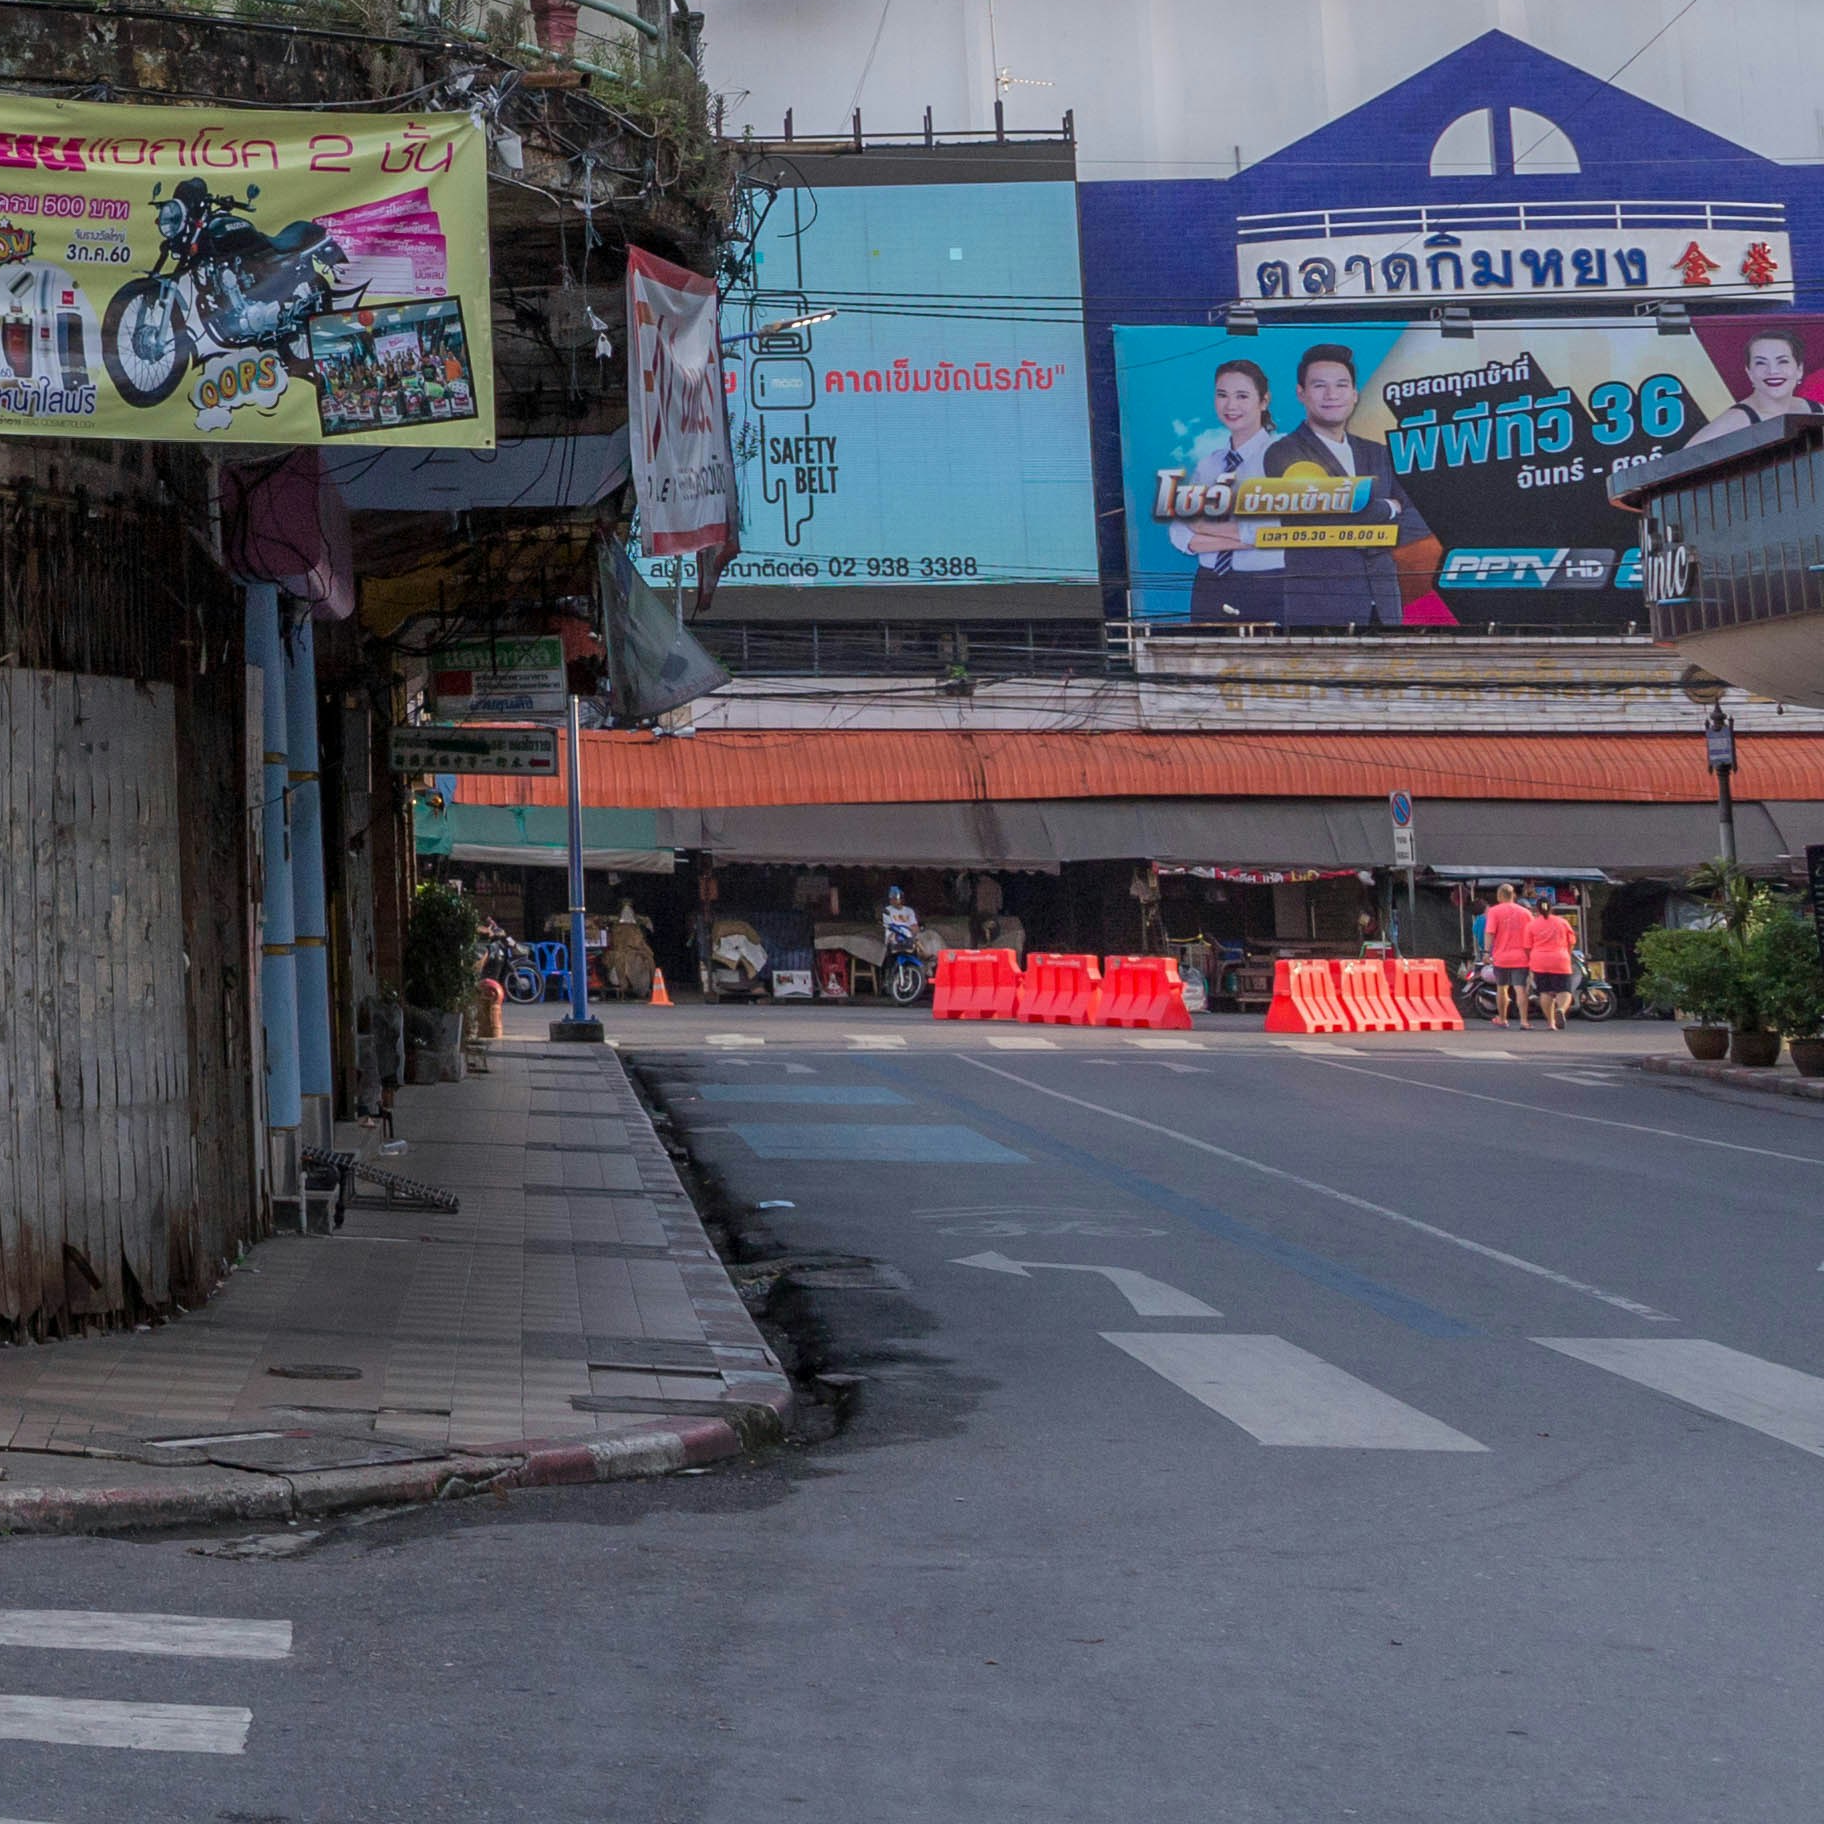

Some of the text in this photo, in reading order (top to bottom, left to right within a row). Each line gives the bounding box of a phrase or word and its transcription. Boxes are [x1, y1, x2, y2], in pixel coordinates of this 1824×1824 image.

[308, 134, 354, 174] 2
[380, 122, 453, 174] ชั้น
[43, 193, 85, 217] 500
[89, 201, 130, 220] บาท
[66, 243, 131, 264] 3ก.ค.60
[1256, 232, 1649, 299] ตลาดกิมหยง
[198, 357, 277, 408] OOPS
[1386, 356, 1530, 407] คุยสดทุกเช้าที่
[1388, 375, 1684, 475] พีพีทีวี 36
[770, 436, 837, 465] SAFETY
[795, 466, 839, 494] BELT
[1517, 456, 1585, 489] จันทร์
[1156, 467, 1237, 518] โชว์
[1243, 480, 1353, 513] ข่าวเช้านี้
[1262, 532, 1289, 542] เวลา
[1291, 530, 1327, 542] 05.30
[1338, 530, 1373, 541] 08.00
[828, 557, 857, 577] 02
[867, 557, 909, 577] 938
[920, 557, 978, 577] 3388
[1450, 548, 1570, 587] PPTV
[1565, 559, 1603, 578] HD
